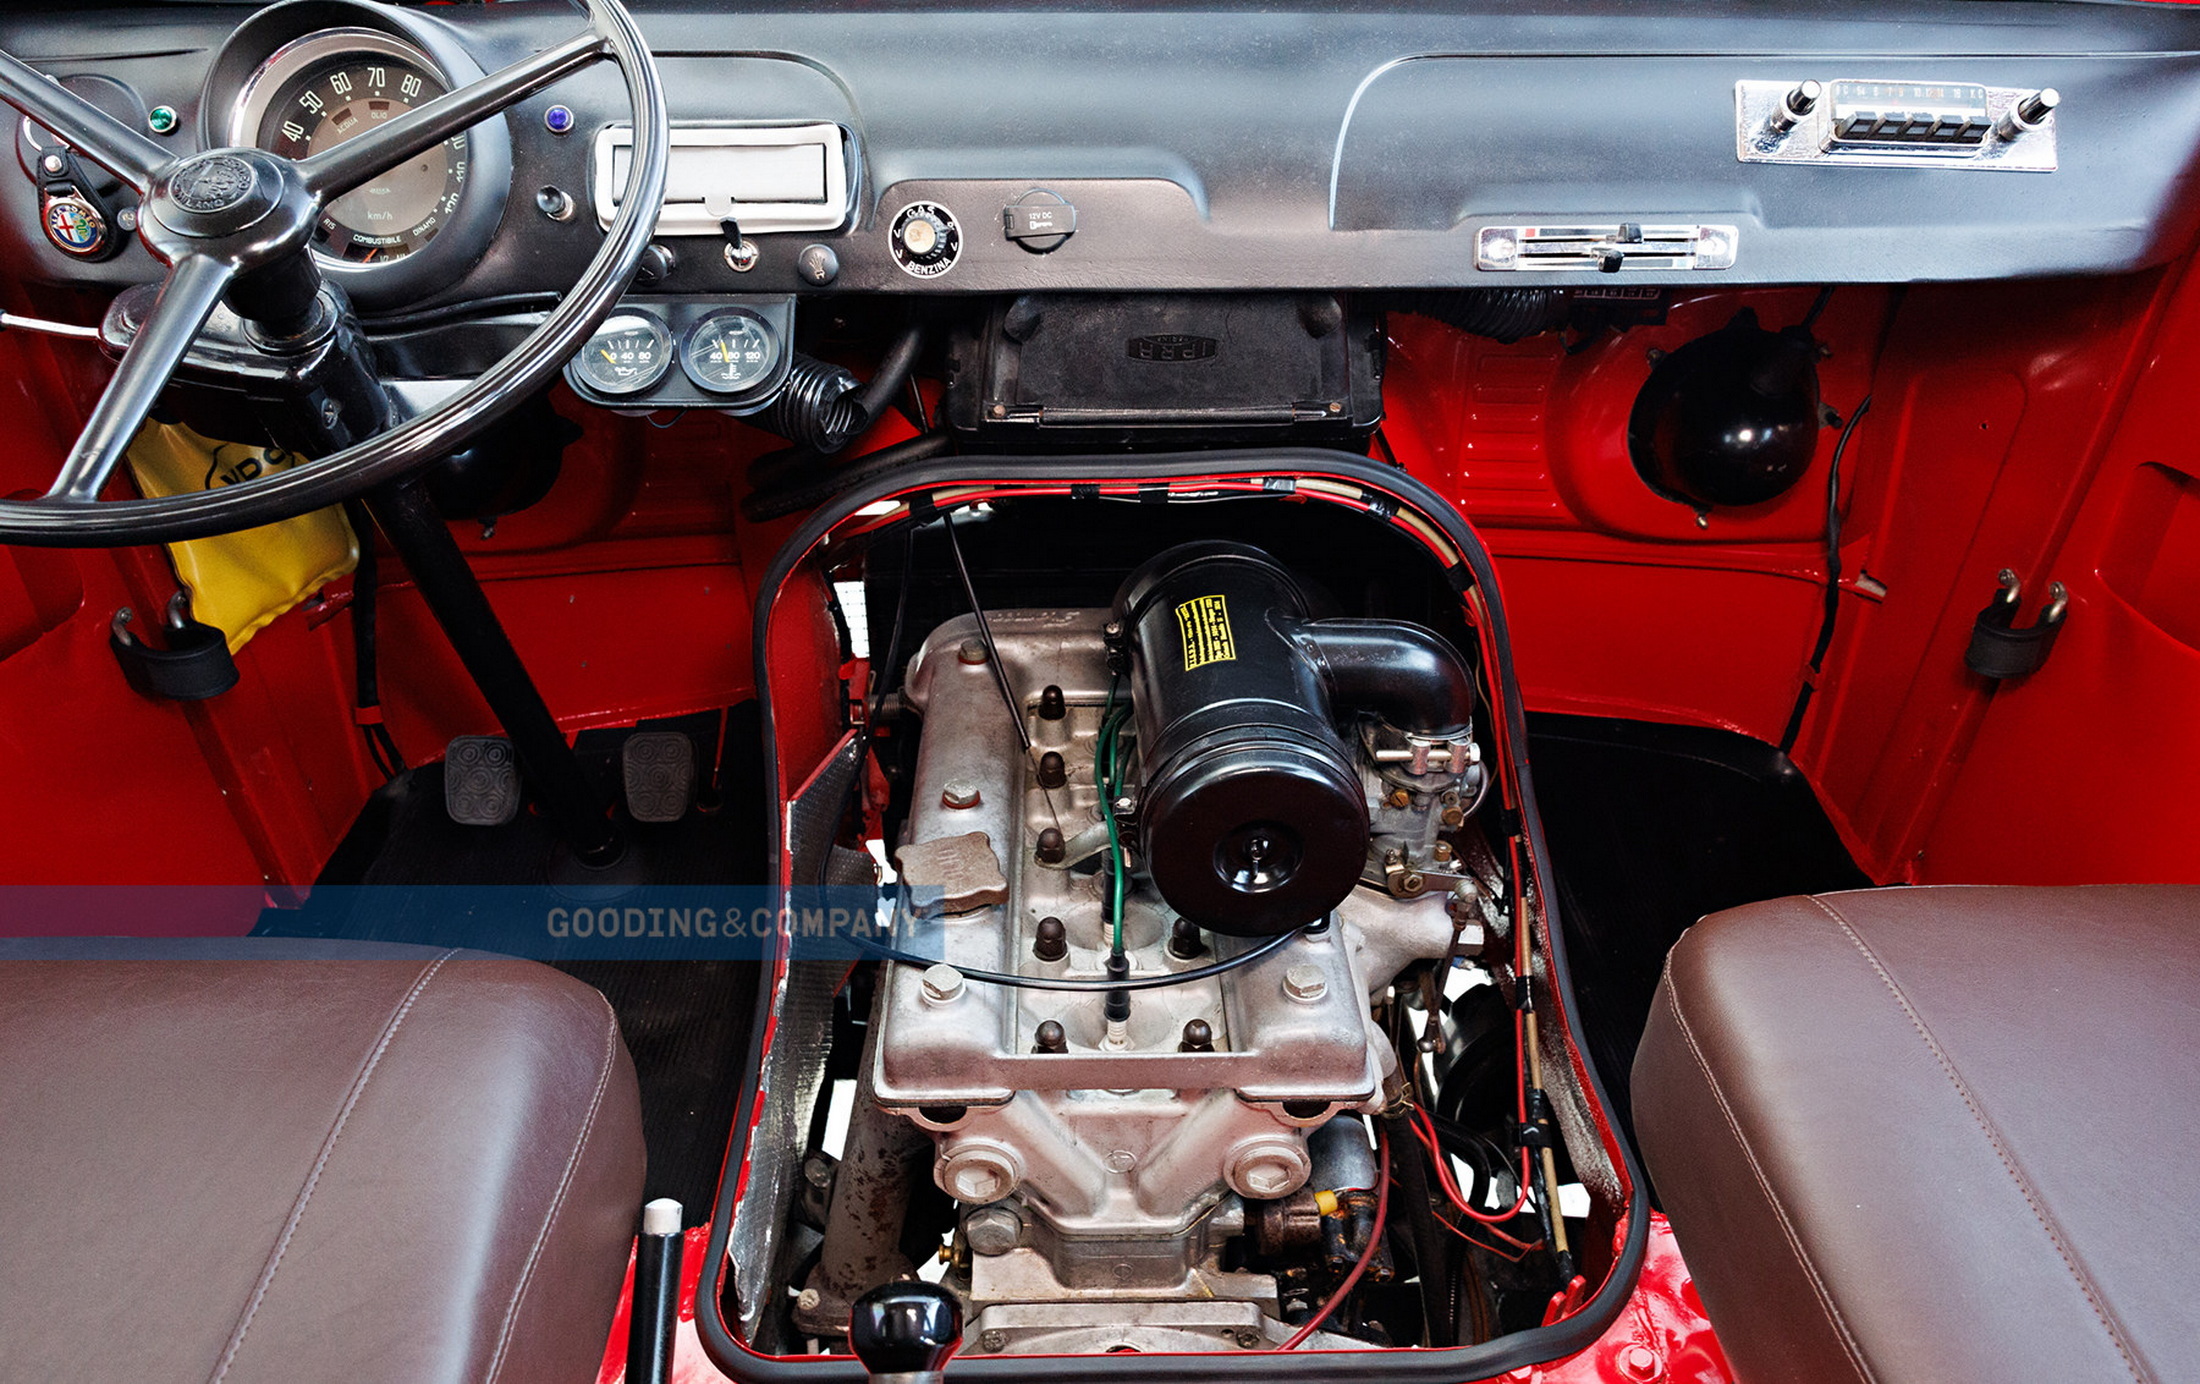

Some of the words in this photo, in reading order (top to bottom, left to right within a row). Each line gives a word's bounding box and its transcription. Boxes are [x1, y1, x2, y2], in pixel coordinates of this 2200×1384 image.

[329, 71, 353, 95] 60
[367, 67, 386, 88] 70
[400, 73, 422, 98] 80
[299, 90, 324, 115] 50
[370, 111, 388, 120] OLIO
[281, 120, 305, 143] 40
[336, 116, 359, 135] ACQUA
[367, 211, 393, 220] km/h
[906, 204, 935, 219] GAS
[1028, 212, 1041, 220] 12V
[1041, 211, 1053, 220] DC
[412, 216, 436, 237] DINAMO
[352, 233, 402, 245] COMBUSTIBILE
[950, 241, 958, 252] V
[895, 249, 903, 259] V
[907, 256, 952, 275] BENZINA
[620, 351, 634, 360] 40
[638, 351, 652, 360] 80
[709, 351, 723, 360] 40
[745, 351, 761, 360] 120
